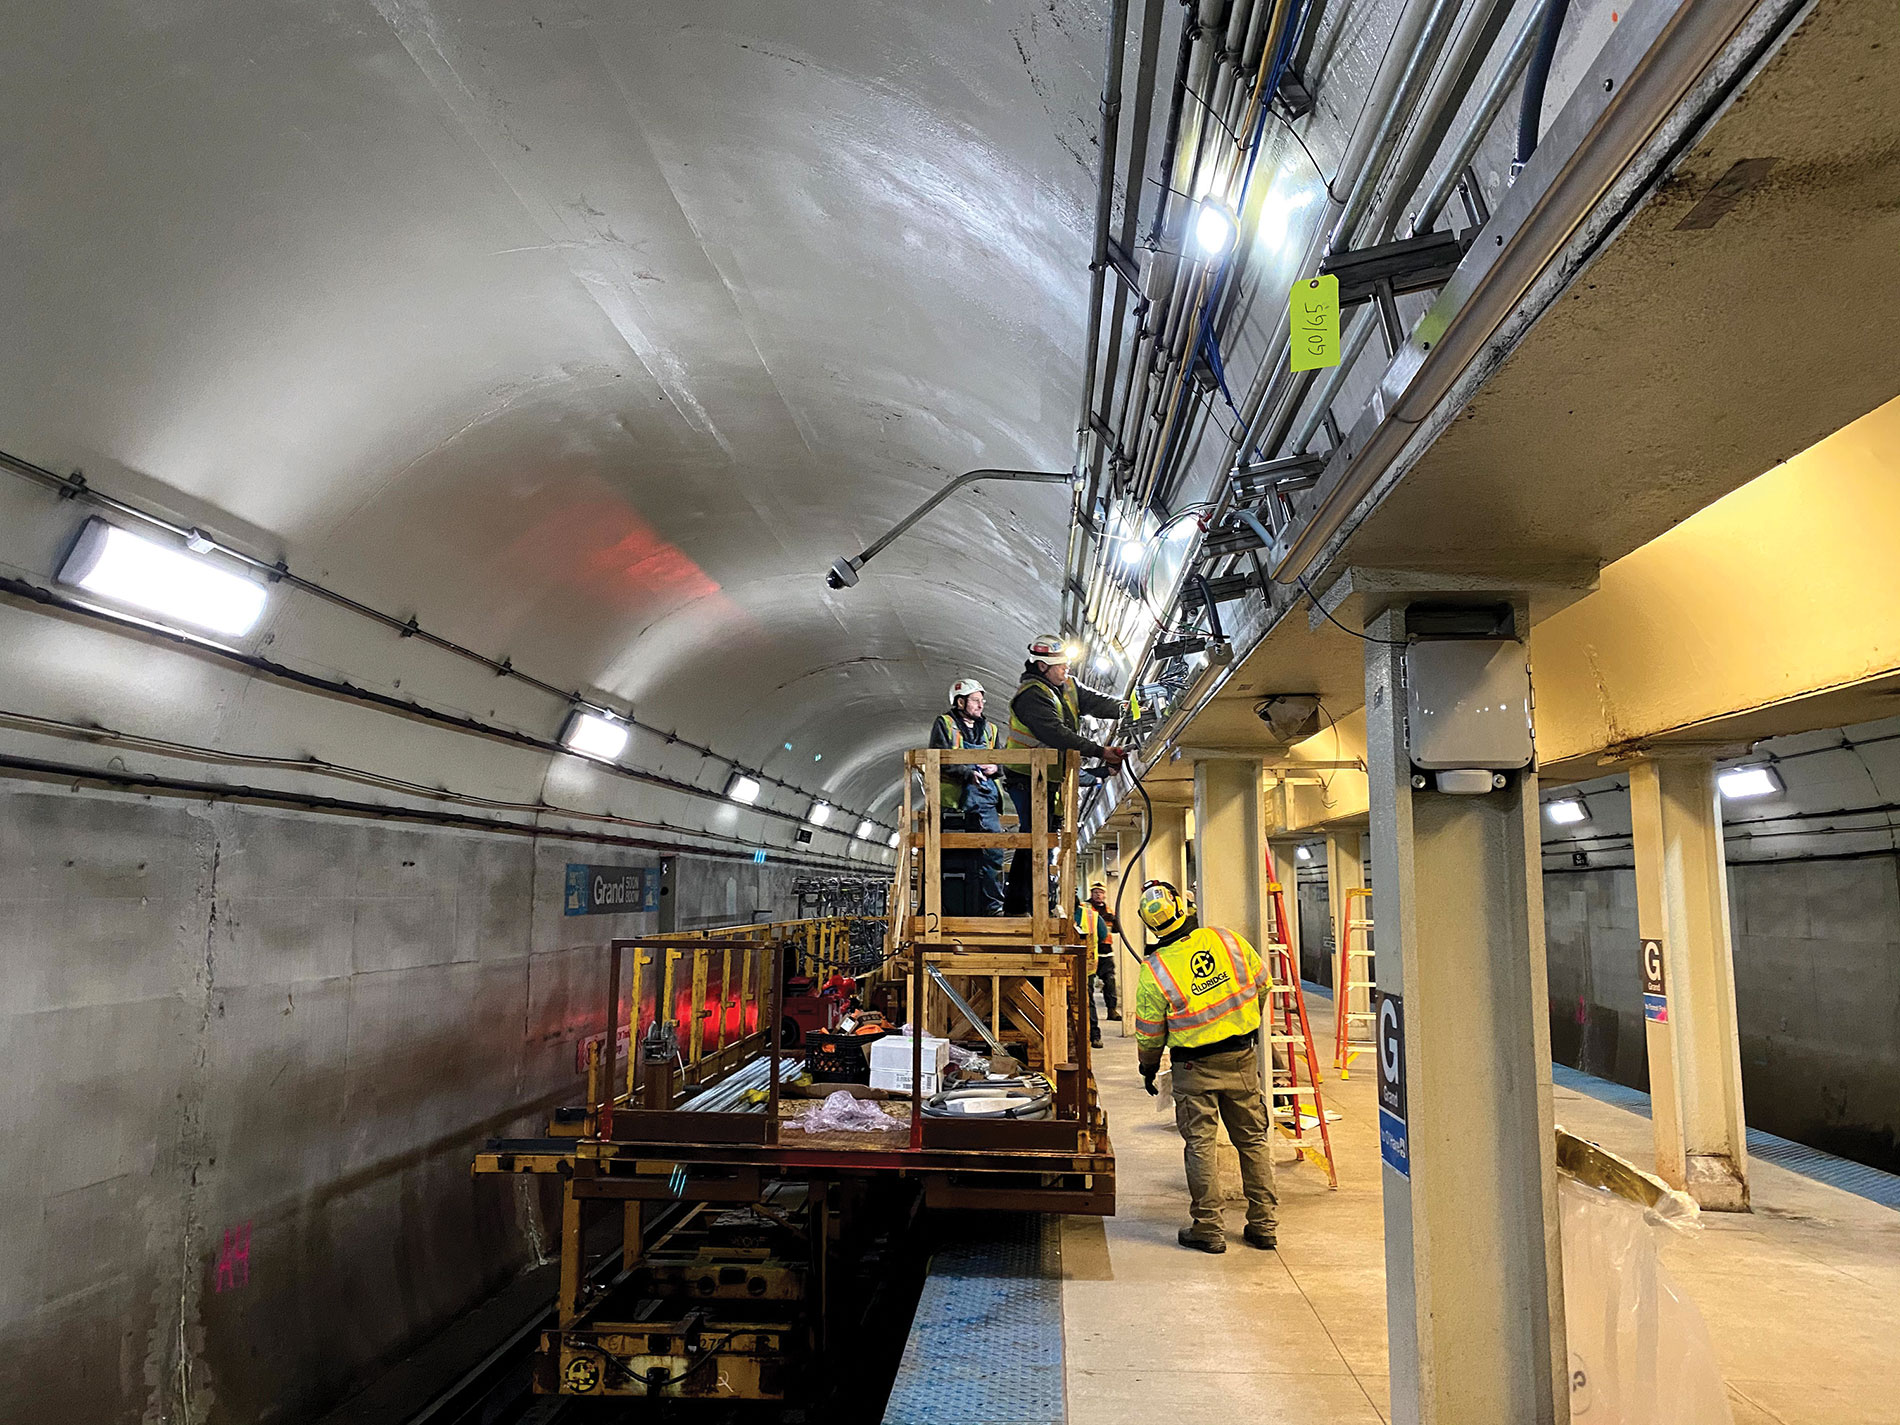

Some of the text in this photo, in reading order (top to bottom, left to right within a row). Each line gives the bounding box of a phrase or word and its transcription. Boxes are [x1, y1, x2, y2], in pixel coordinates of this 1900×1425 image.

[594, 875, 625, 905] Grand
[927, 912, 939, 933] 2
[1644, 941, 1661, 981] G
[1648, 982, 1661, 992] Grand
[1380, 998, 1399, 1085] G
[1383, 1085, 1399, 1108] Grand
